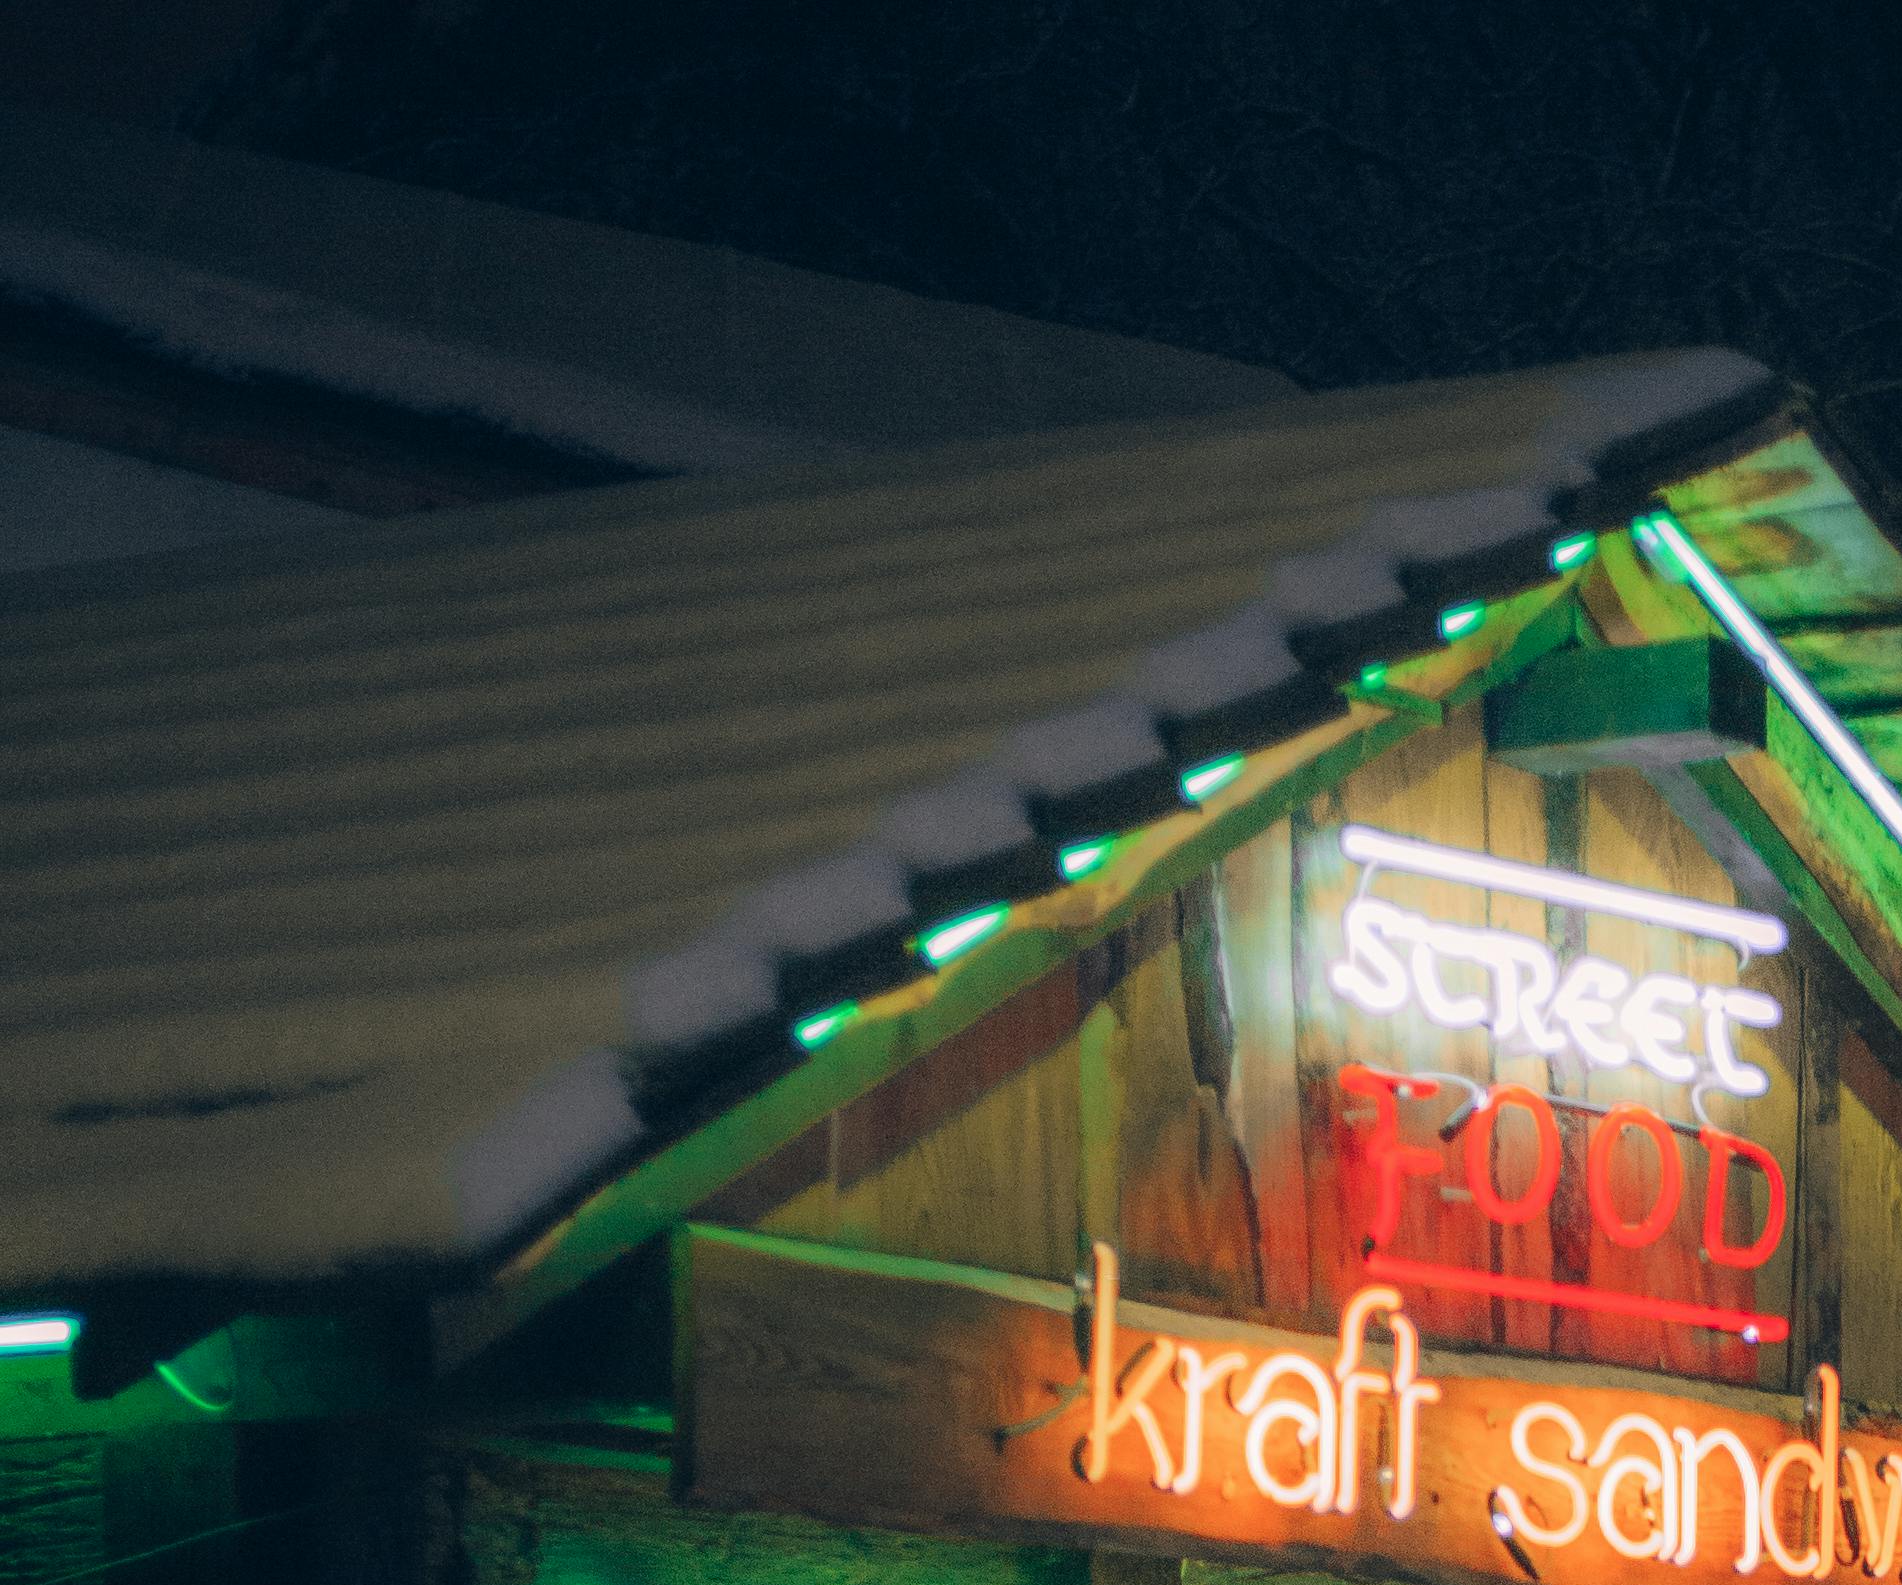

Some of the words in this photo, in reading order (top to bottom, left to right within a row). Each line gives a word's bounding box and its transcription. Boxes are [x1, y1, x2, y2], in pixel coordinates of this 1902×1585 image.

[1333, 897, 1782, 1095] STREET
[1338, 1063, 1787, 1268] FOOD
[1084, 1242, 1439, 1520] kraft
